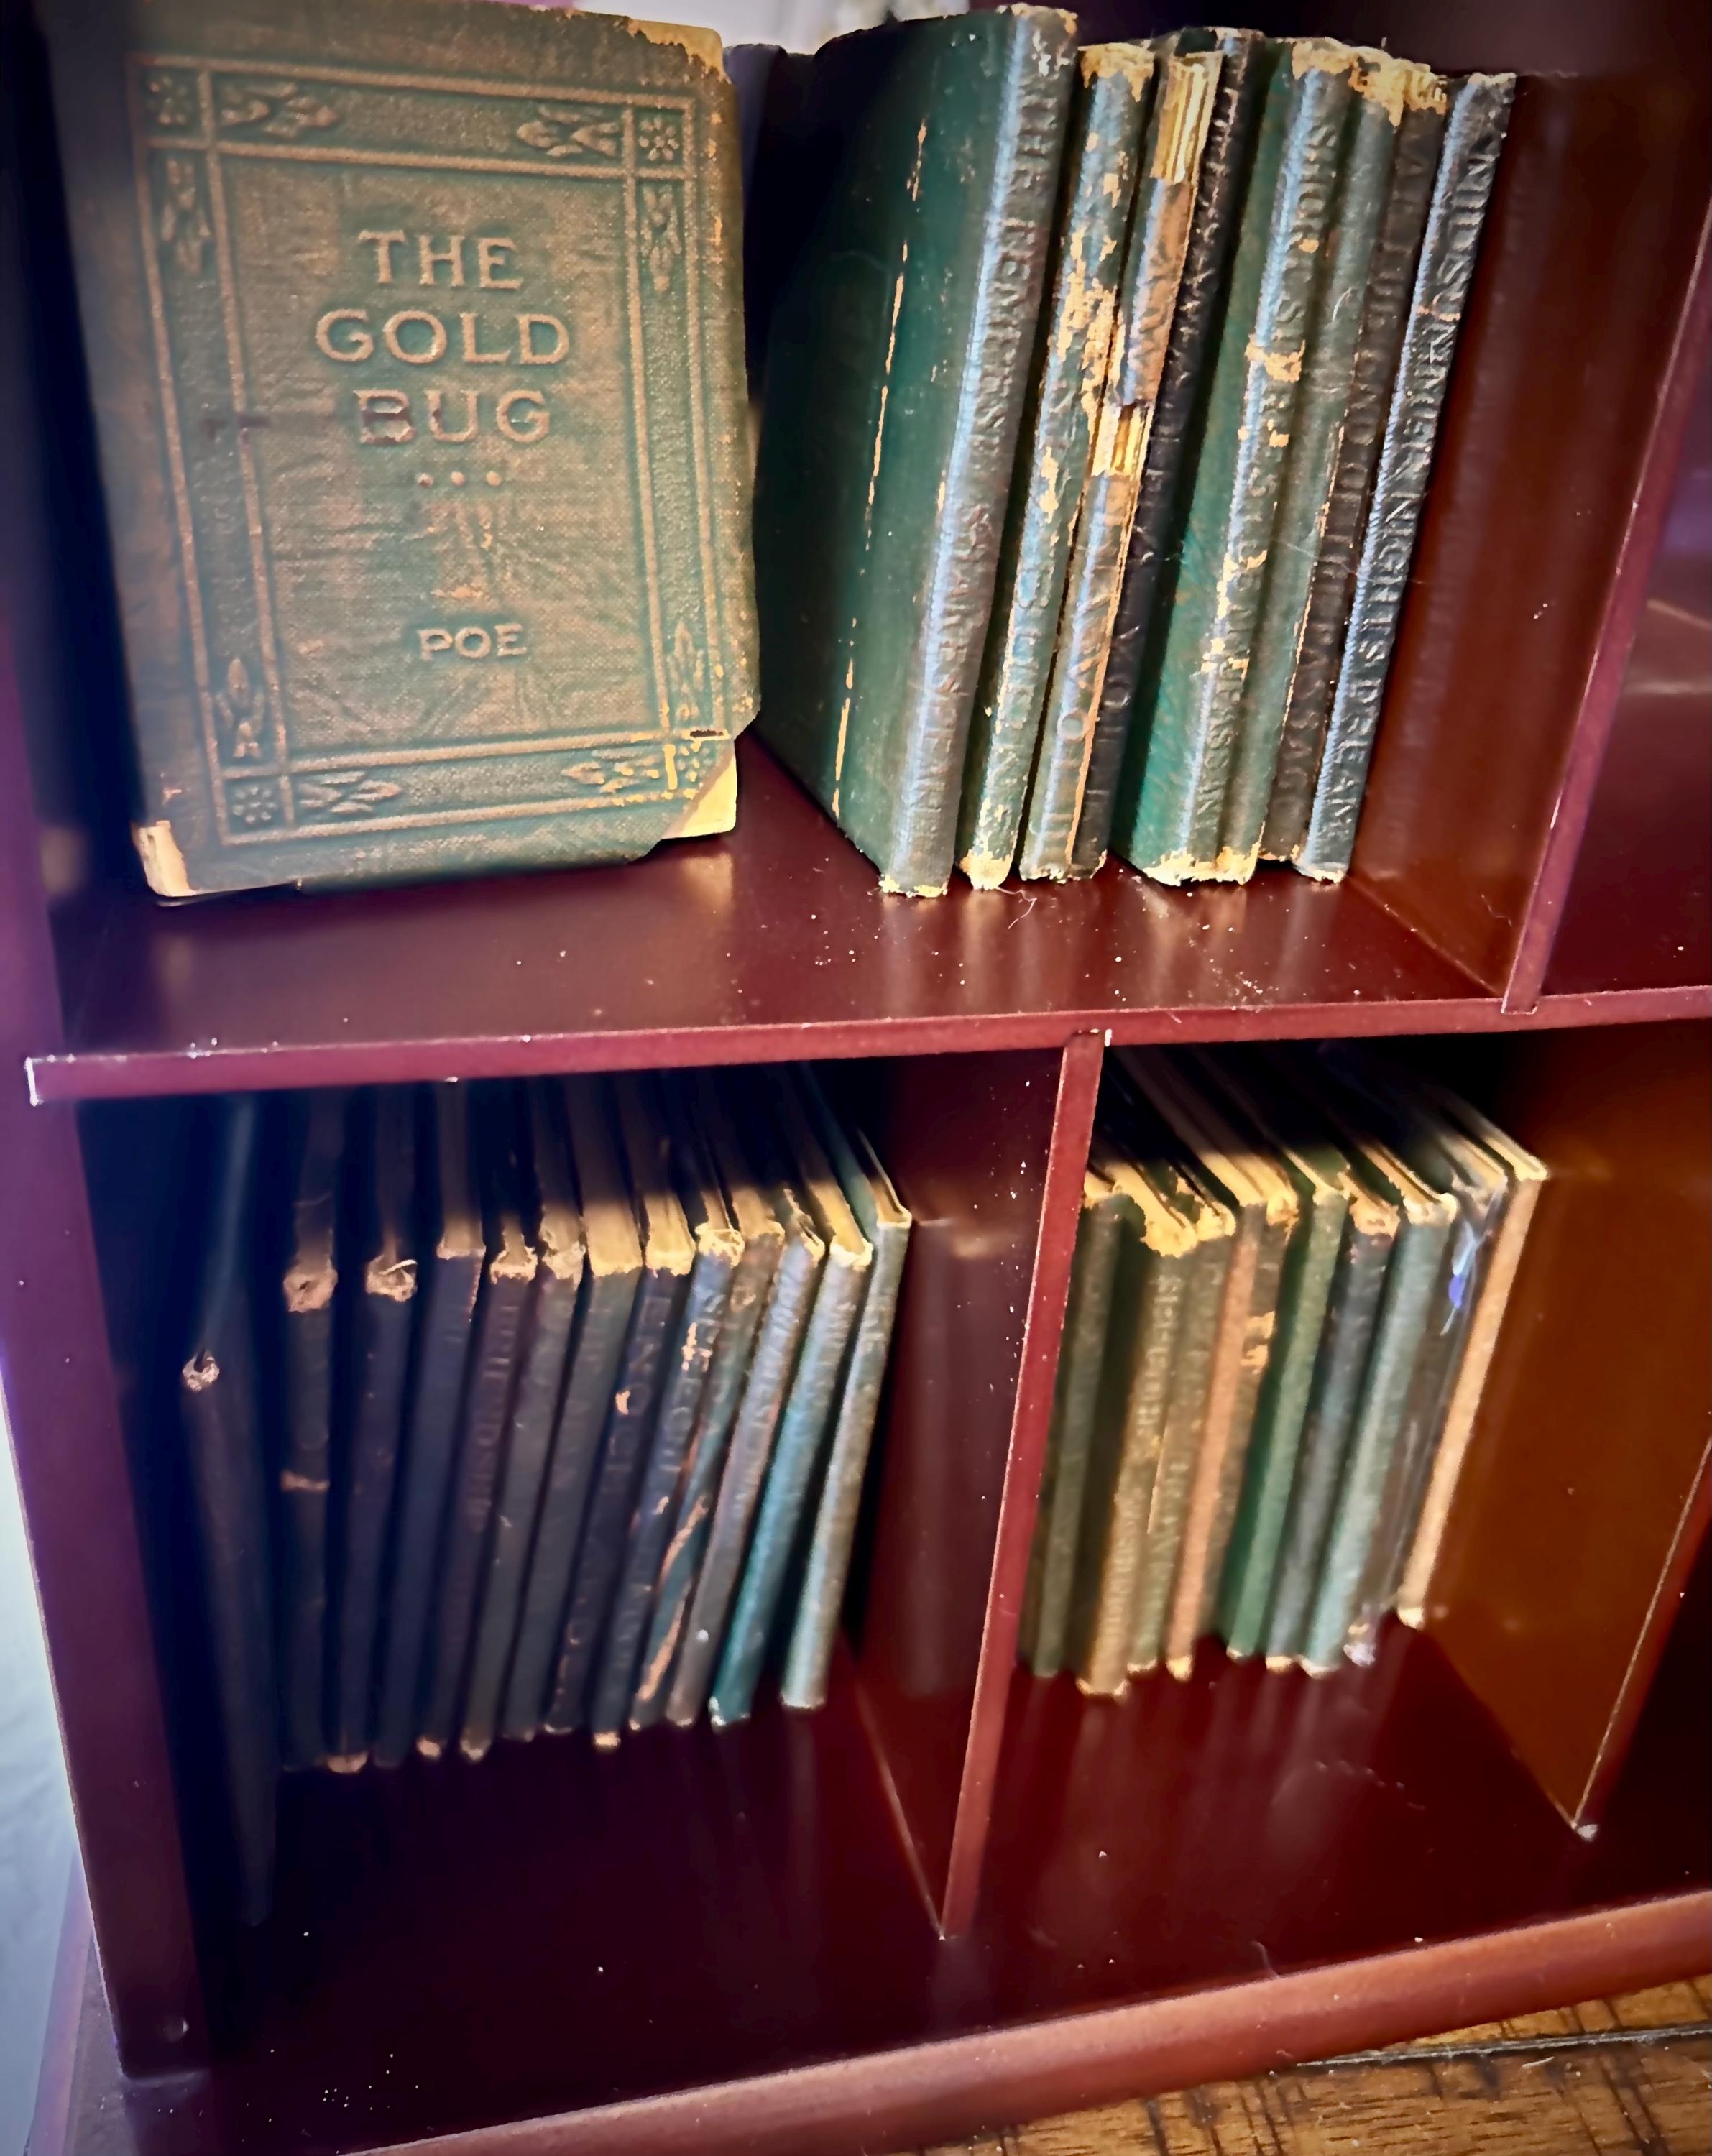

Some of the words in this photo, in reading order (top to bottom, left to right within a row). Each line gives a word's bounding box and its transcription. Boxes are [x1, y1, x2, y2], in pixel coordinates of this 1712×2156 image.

[358, 229, 523, 290] THE
[315, 309, 570, 364] GOLD
[354, 390, 550, 444] BUG
[418, 623, 527, 660] POE
[1320, 676, 1383, 829] DREAM
